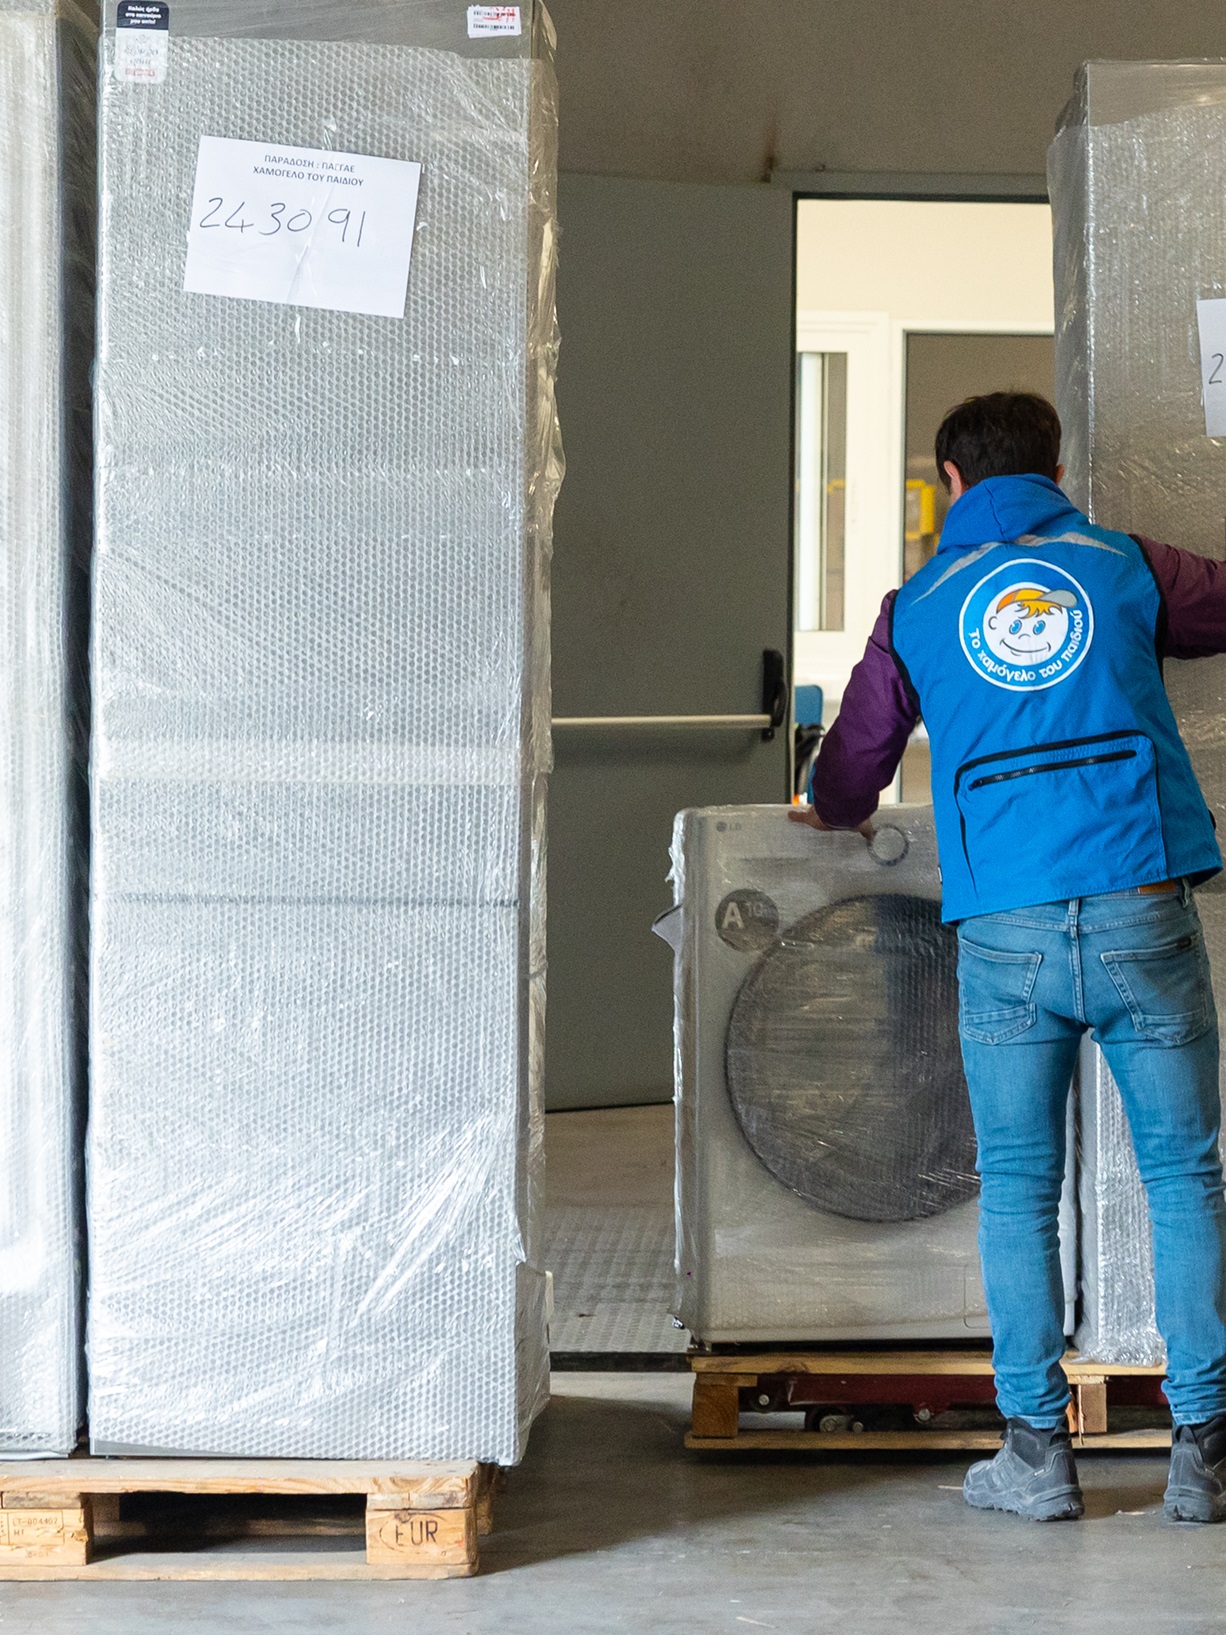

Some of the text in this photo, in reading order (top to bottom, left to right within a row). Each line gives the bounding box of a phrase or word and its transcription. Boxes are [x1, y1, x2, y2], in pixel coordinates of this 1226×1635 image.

[264, 154, 315, 169] ΠΑΡΑΔΟΣΗ
[253, 166, 364, 187] ΧΑΜΟΓΕΛΟ ΤΟΥ ΠΑΙΔΙΟΥ
[968, 609, 1083, 682] Το χαμόγελο του παιδιού
[395, 1520, 438, 1546] EUR
